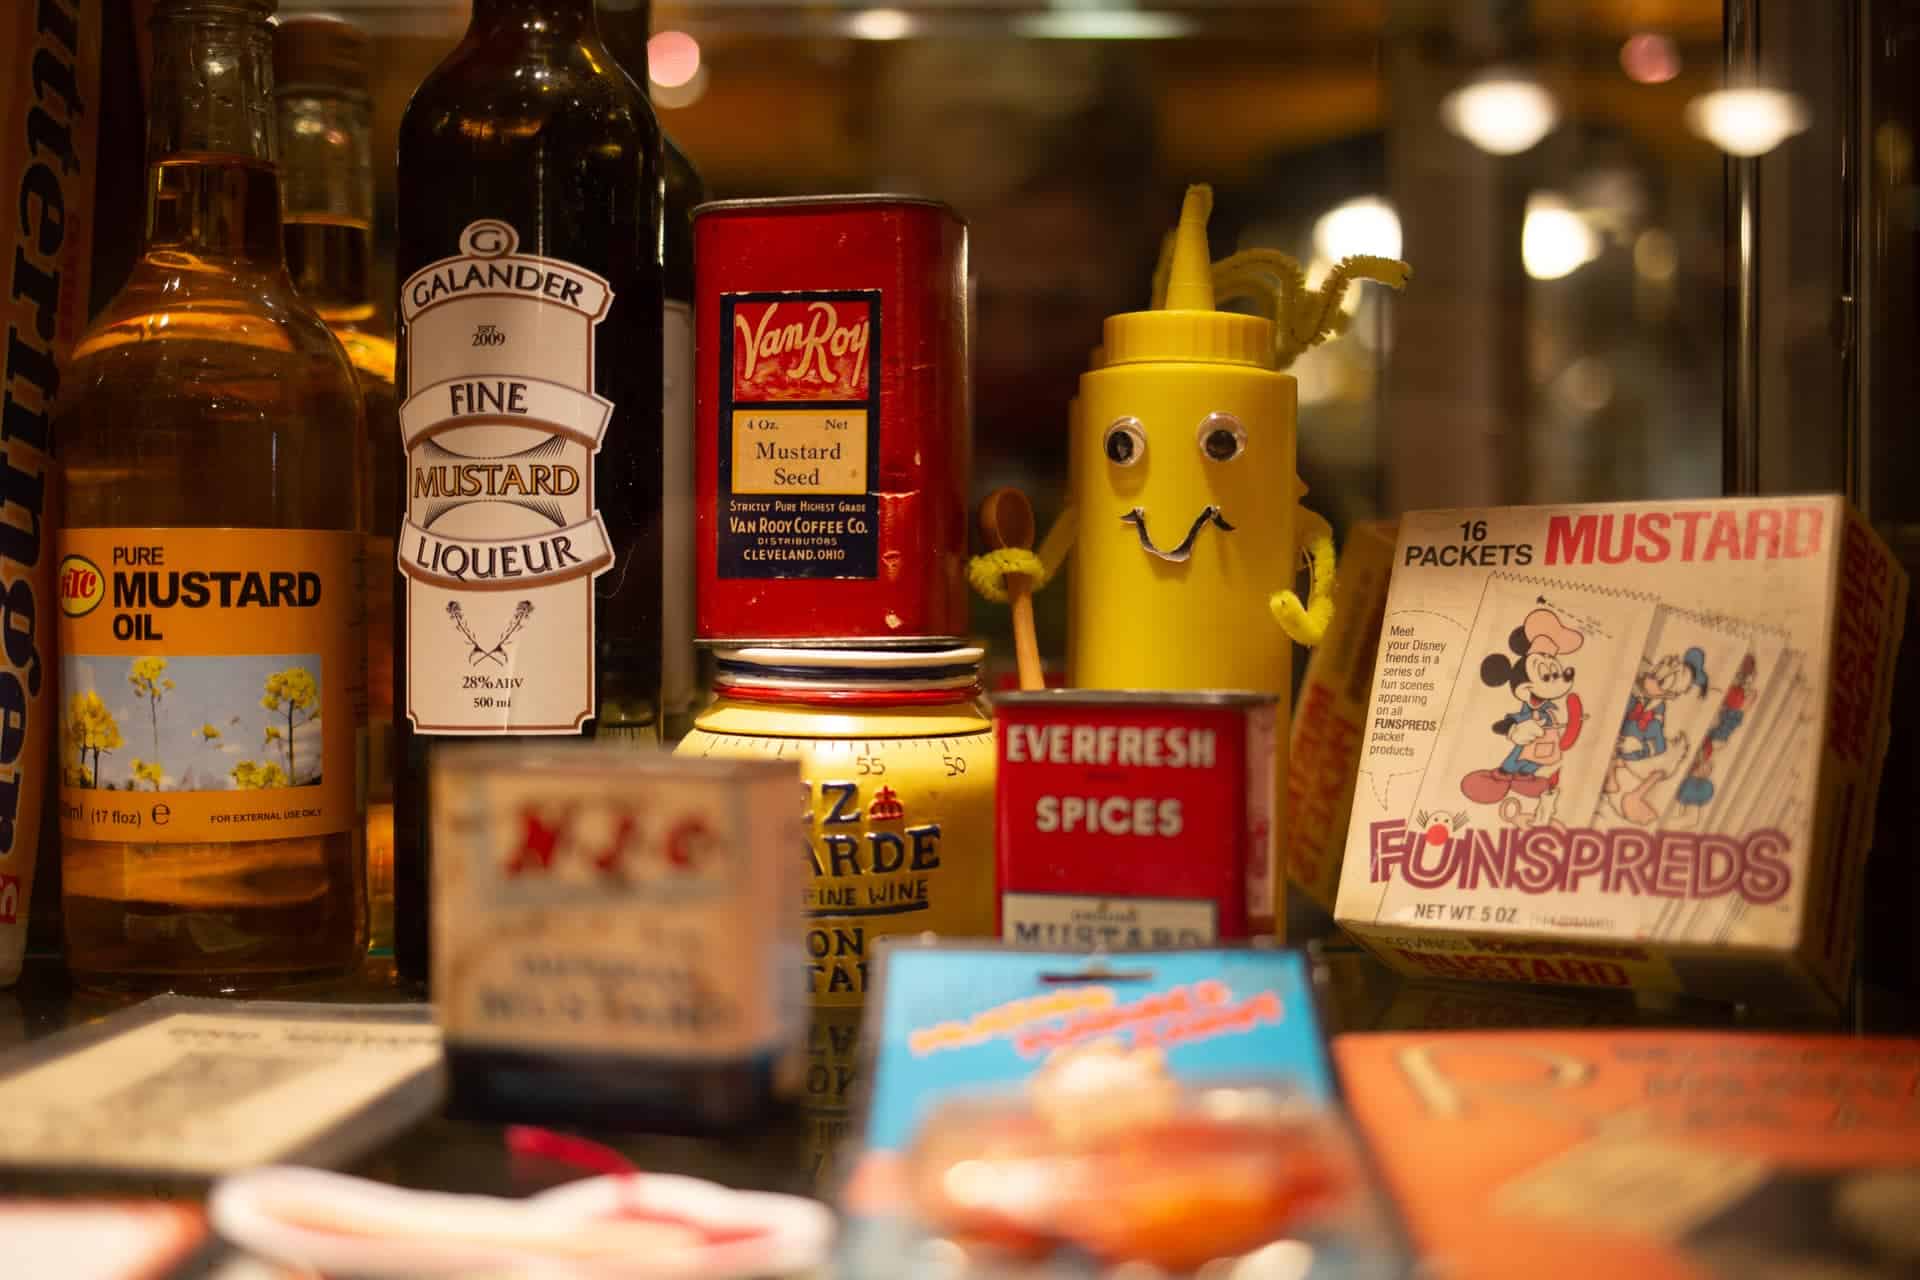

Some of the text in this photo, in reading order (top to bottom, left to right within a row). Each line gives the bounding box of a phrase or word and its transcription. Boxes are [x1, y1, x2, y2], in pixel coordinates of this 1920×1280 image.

[412, 263, 584, 308] GALANDER
[471, 332, 506, 347] 2009
[449, 381, 529, 416] FINE
[758, 420, 779, 430] Oz.
[824, 420, 848, 430] Net
[756, 441, 841, 460] Mustard
[413, 463, 580, 498] MUSTARD
[774, 467, 820, 486] Seed
[775, 500, 797, 513] PURE
[800, 501, 835, 513] HIGHEST
[838, 502, 867, 513] GRADE
[729, 516, 869, 534] VAN ROOY COFFEE CO.
[1459, 520, 1488, 542] 16
[758, 537, 838, 546] DISTRIBUTORS
[1543, 506, 1824, 567] MUSTARD
[112, 547, 165, 566] PURE
[415, 536, 582, 582] LIQUEUR
[1404, 543, 1533, 567] PACKETS
[112, 572, 322, 609] MUSTARD
[112, 614, 164, 641] OIL
[1390, 626, 1415, 637] Meet
[1387, 640, 1447, 652] your Disney
[1385, 653, 1419, 664] friends
[1421, 653, 1431, 664] in
[1383, 667, 1426, 677] series of
[461, 676, 494, 689] 28%
[1380, 679, 1435, 691] fun scenes
[473, 697, 511, 708] 500 ml
[1377, 693, 1428, 706] appearing
[1376, 706, 1403, 716] on all
[1374, 718, 1438, 731] FUNSPREDS
[1005, 723, 1217, 769] EVERFRESH
[1371, 731, 1405, 743] packet
[1369, 744, 1415, 757] products
[856, 756, 967, 776] 55 50
[210, 815, 230, 824] FOR
[232, 811, 282, 823] EXTERNAL
[283, 809, 303, 820] USE
[1035, 795, 1184, 838] SPICES
[1369, 818, 1793, 905] FUNSPREDS
[868, 880, 929, 904] WINE
[1414, 903, 1446, 921] NET
[1480, 906, 1490, 922] 5
